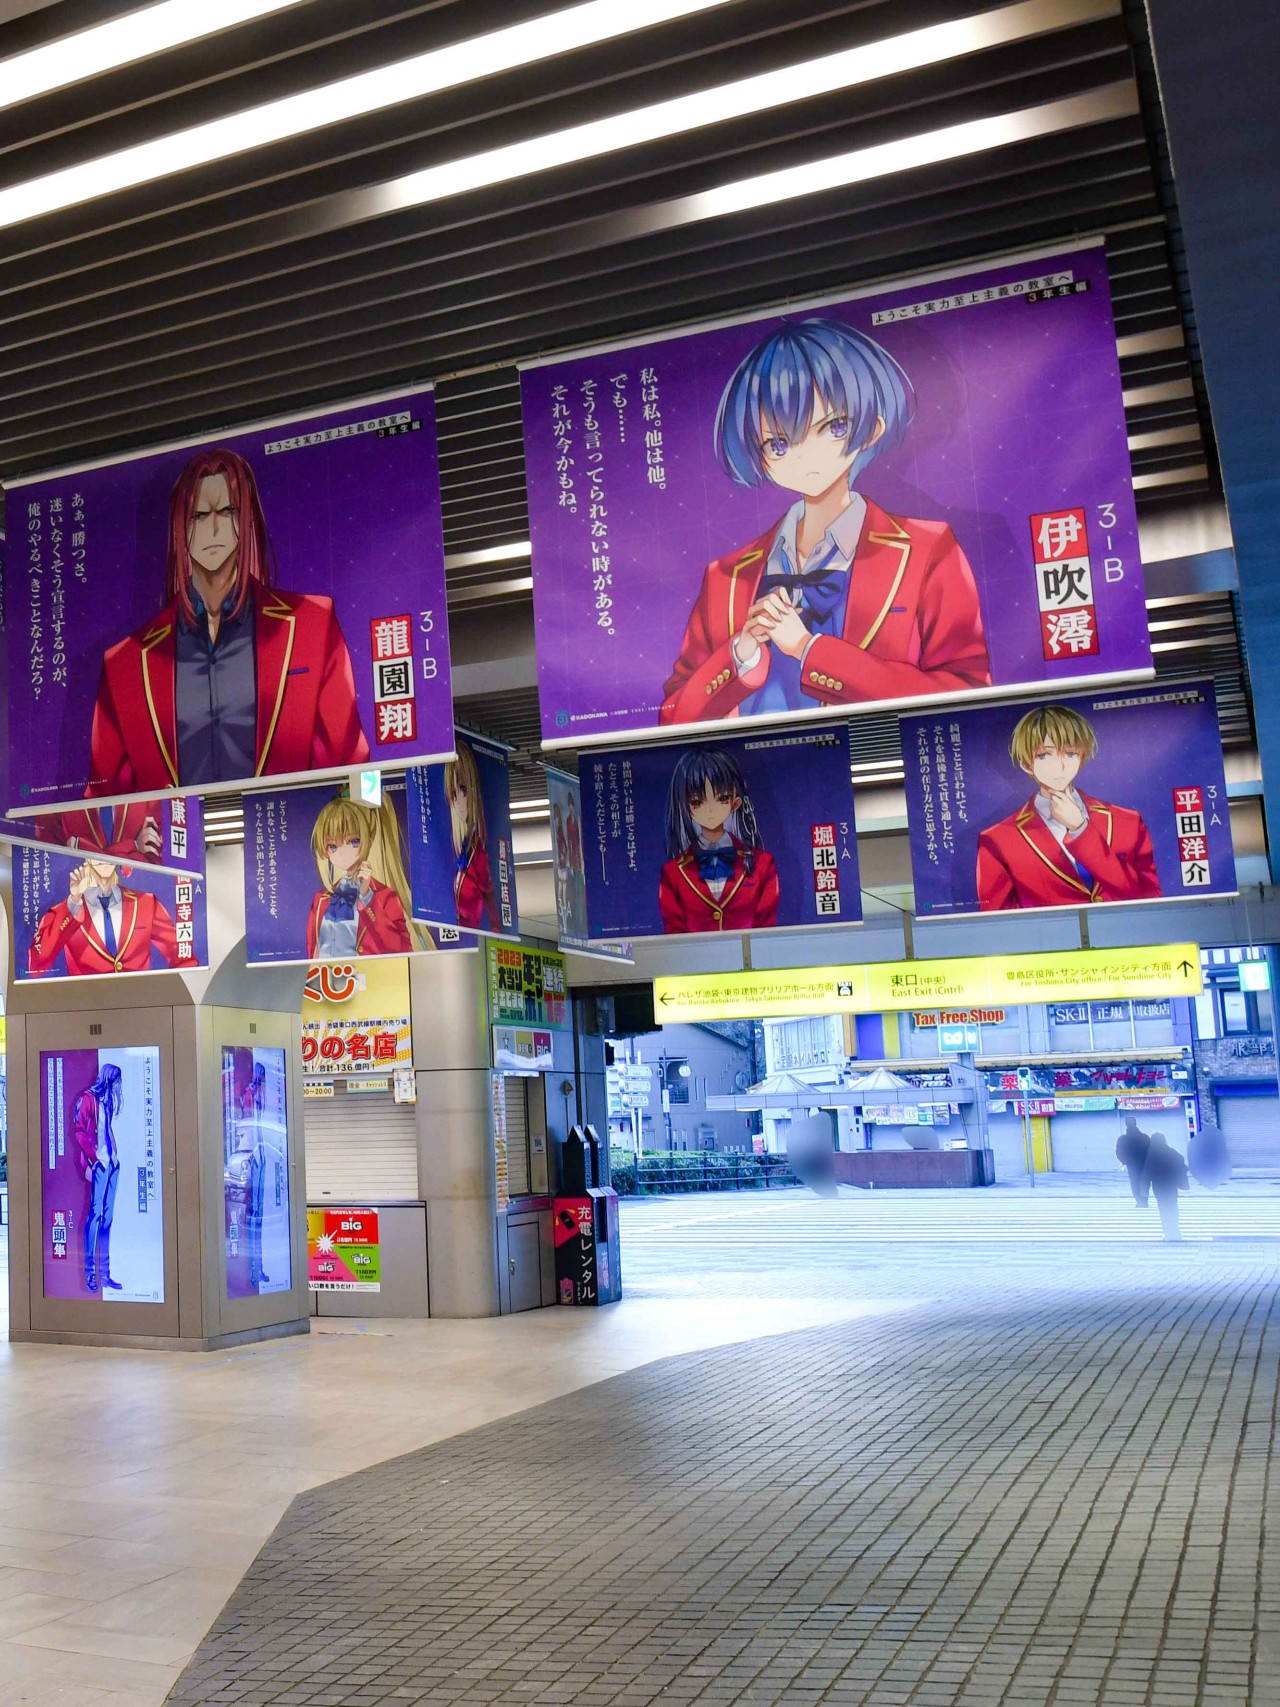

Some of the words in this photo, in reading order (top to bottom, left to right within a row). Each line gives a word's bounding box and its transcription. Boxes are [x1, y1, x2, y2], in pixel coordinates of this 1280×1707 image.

[874, 272, 1071, 324] ようこそ実力至上主義の教室へ
[1028, 282, 1088, 302] 3年生編
[266, 413, 409, 453] ようこそ実力至上主義の教室へ
[550, 386, 577, 514] それが今かもね。
[639, 369, 666, 490] 私は私。他は他。
[580, 379, 615, 637] そうも言ってられない時がある。
[49, 498, 67, 688] 迷いなくそう宣言するのが、
[1037, 515, 1094, 655] 伊吹澪
[374, 620, 414, 741] 龍園翔
[608, 763, 621, 838] たとえ、その相手が
[622, 761, 637, 871] 仲間がいれば勝てるはずよ。
[917, 728, 939, 865] それが僕の在り方だと思うから。
[933, 725, 954, 853] それを最後まで貫き通したい。
[949, 723, 968, 823] 綺麗ごとと言われても、
[171, 798, 186, 855] 康平
[256, 803, 265, 904] ちゃんと思い出したつもり。
[279, 800, 287, 842] どうしても
[1177, 789, 1210, 884] 平田洋介
[814, 826, 839, 913] 堀北鈴音
[892, 988, 911, 997] East
[914, 987, 932, 996] Exit
[1007, 961, 1171, 980] 豊島区役所・サンシャインシティ方面
[1097, 1005, 1123, 1019] 正規
[302, 1032, 397, 1062] りの名店
[914, 1013, 936, 1026] Tax
[940, 1011, 967, 1024] Free
[970, 1009, 1004, 1023] Shop
[54, 1212, 66, 1257] 鬼頭隼
[578, 1206, 595, 1298] 充電レンタル
